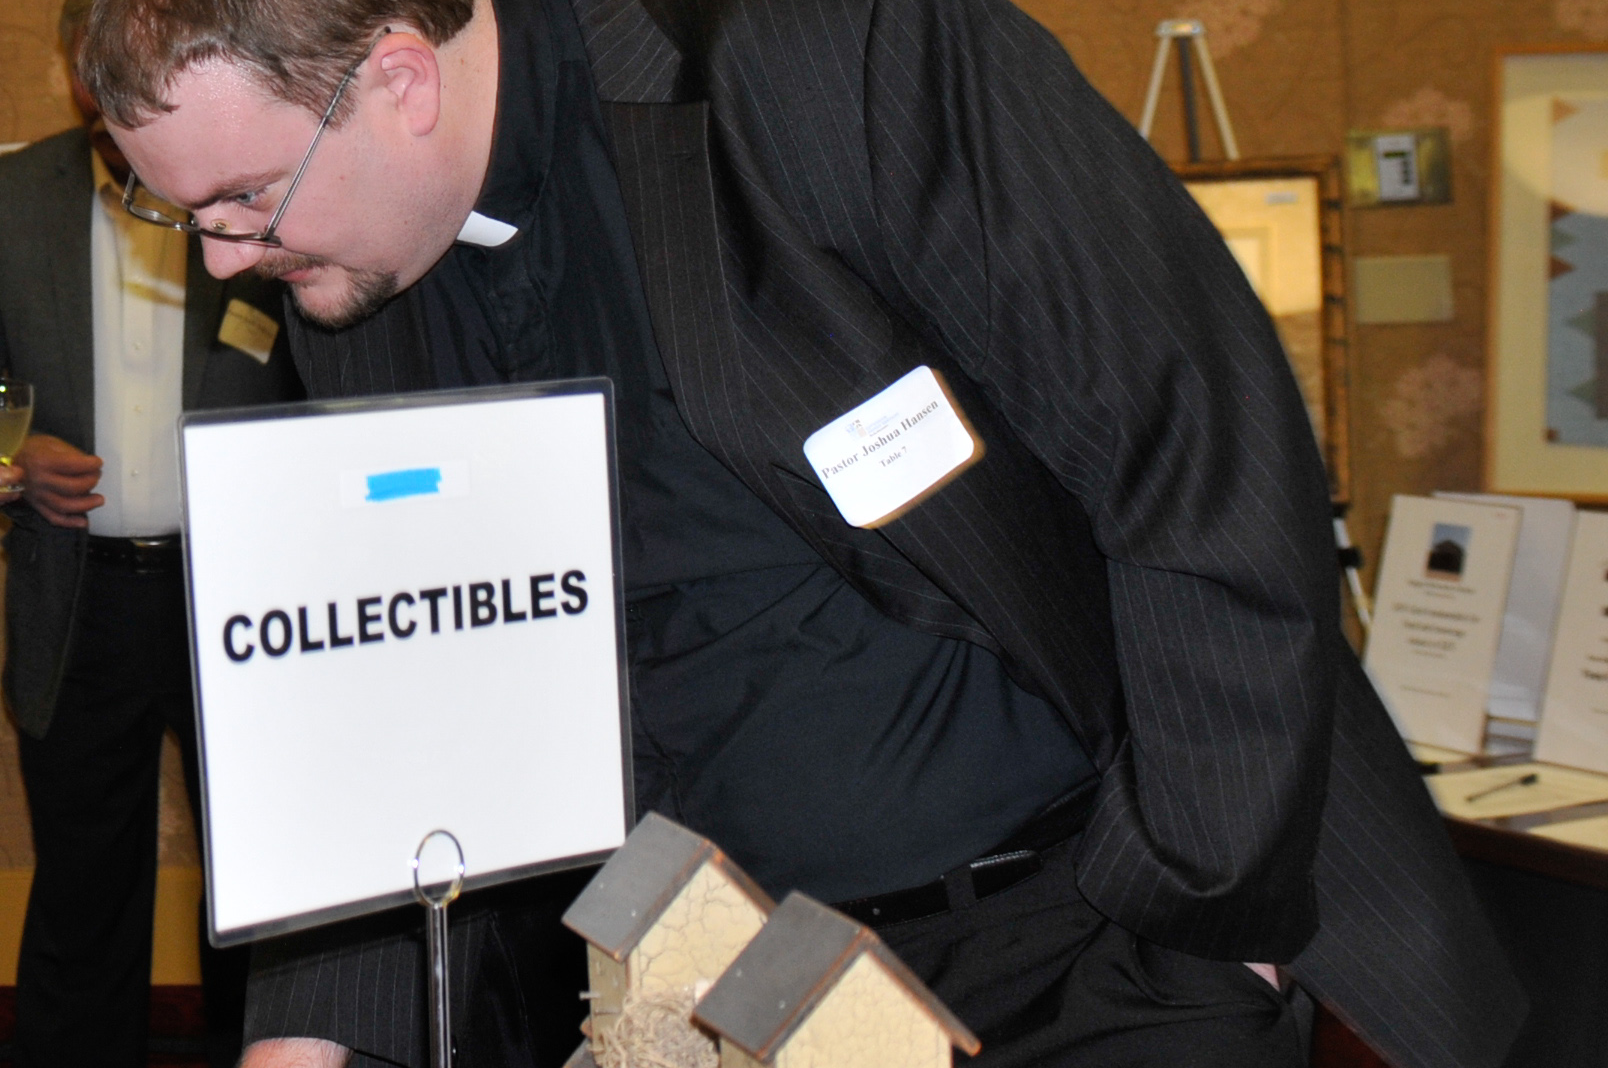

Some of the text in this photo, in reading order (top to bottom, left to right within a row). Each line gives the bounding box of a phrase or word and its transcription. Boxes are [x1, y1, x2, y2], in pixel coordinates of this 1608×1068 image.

[821, 452, 859, 480] Pastor
[862, 429, 901, 457] Joshua
[901, 399, 939, 431] Hansen
[878, 451, 901, 467] Table
[223, 569, 589, 663] COLLECTIBLES
